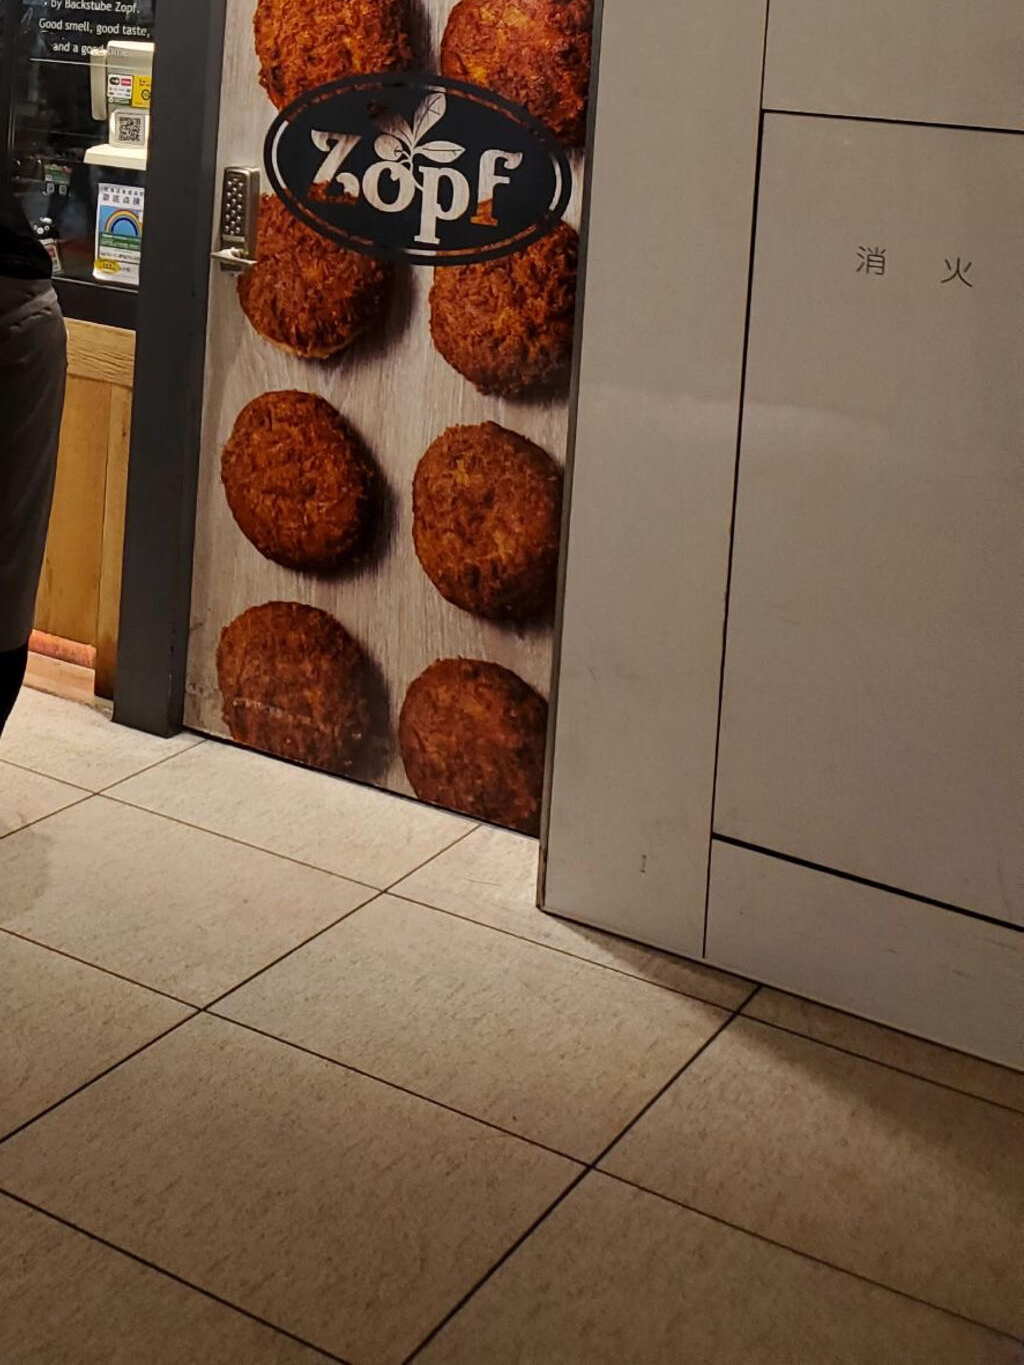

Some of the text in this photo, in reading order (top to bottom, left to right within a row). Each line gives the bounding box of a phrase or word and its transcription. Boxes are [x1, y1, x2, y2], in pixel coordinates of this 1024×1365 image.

[115, 1, 140, 16] Zopf.
[38, 17, 151, 39] Good smell, good taste,
[52, 41, 71, 52] and
[72, 44, 78, 52] a
[307, 129, 524, 245] Zopf
